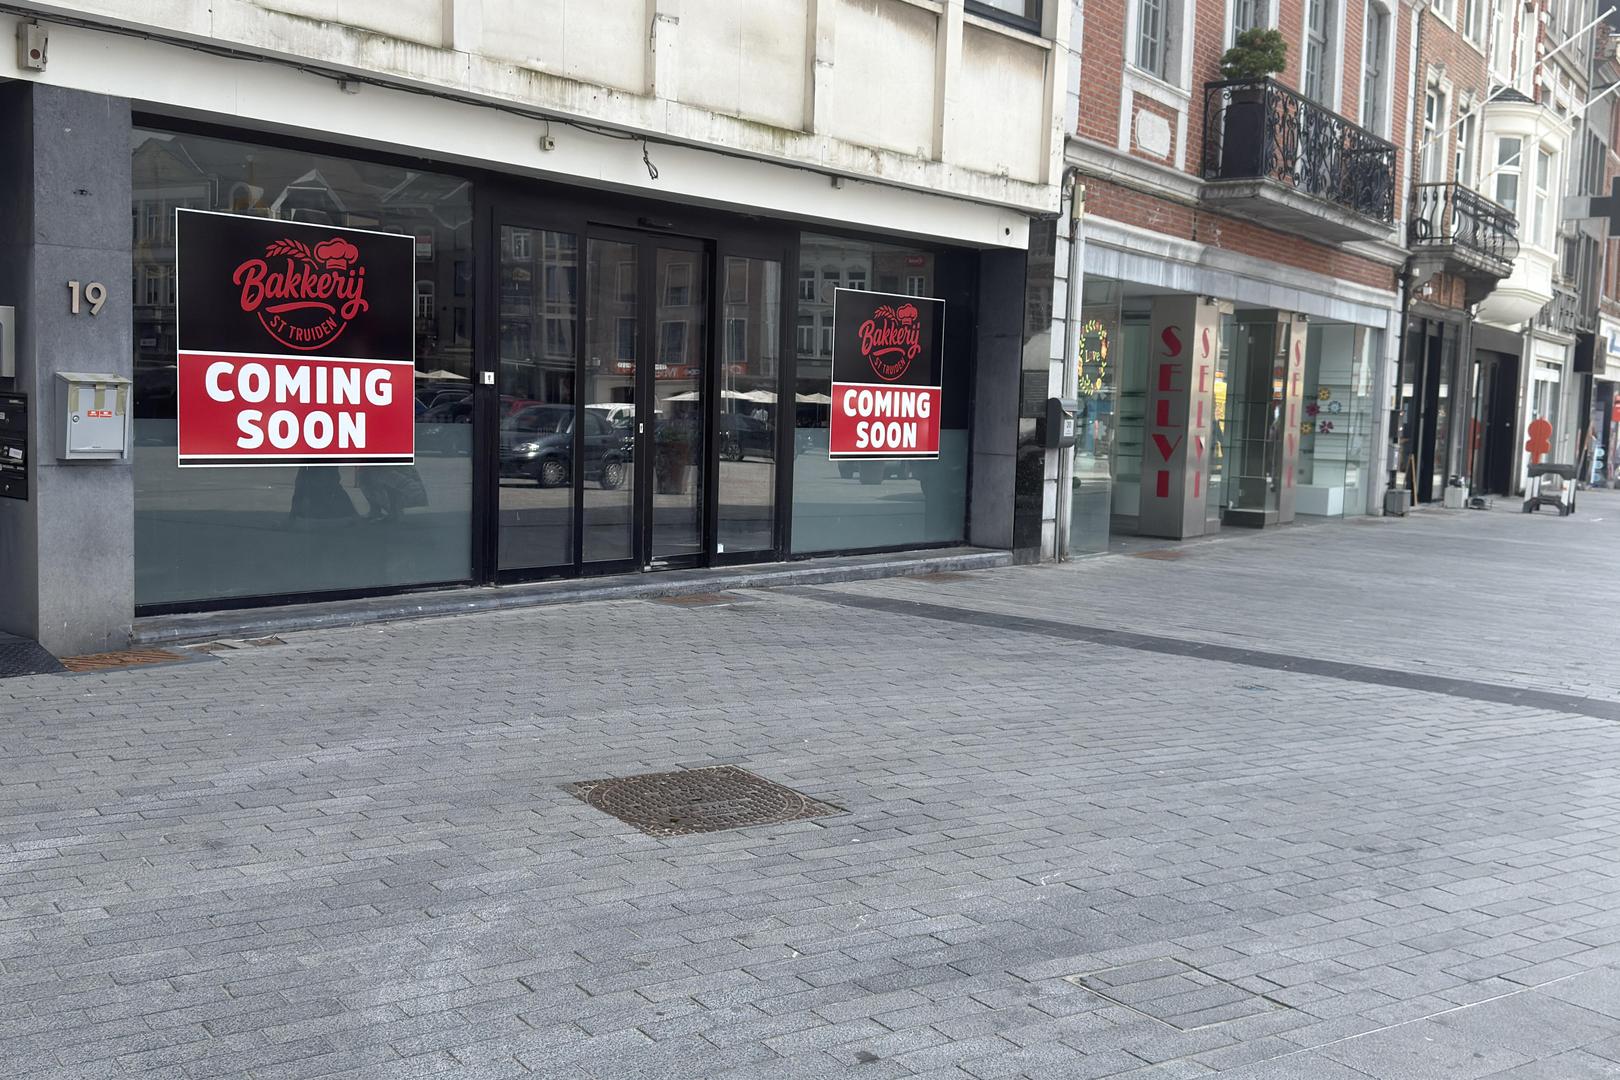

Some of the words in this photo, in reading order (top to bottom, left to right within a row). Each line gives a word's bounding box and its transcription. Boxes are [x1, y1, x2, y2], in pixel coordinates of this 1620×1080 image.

[67, 280, 108, 316] 19
[232, 258, 369, 320] Bakkerij
[270, 315, 287, 332] ST
[289, 317, 338, 342] TRUIDEN
[858, 318, 921, 360] Bakkerij
[205, 361, 393, 407] COMING
[874, 356, 882, 369] ST
[882, 356, 906, 375] TRUIDEN
[843, 389, 931, 419] COMING
[1152, 325, 1183, 497] SELVI
[236, 409, 366, 449] SOON
[856, 421, 917, 449] SOON
